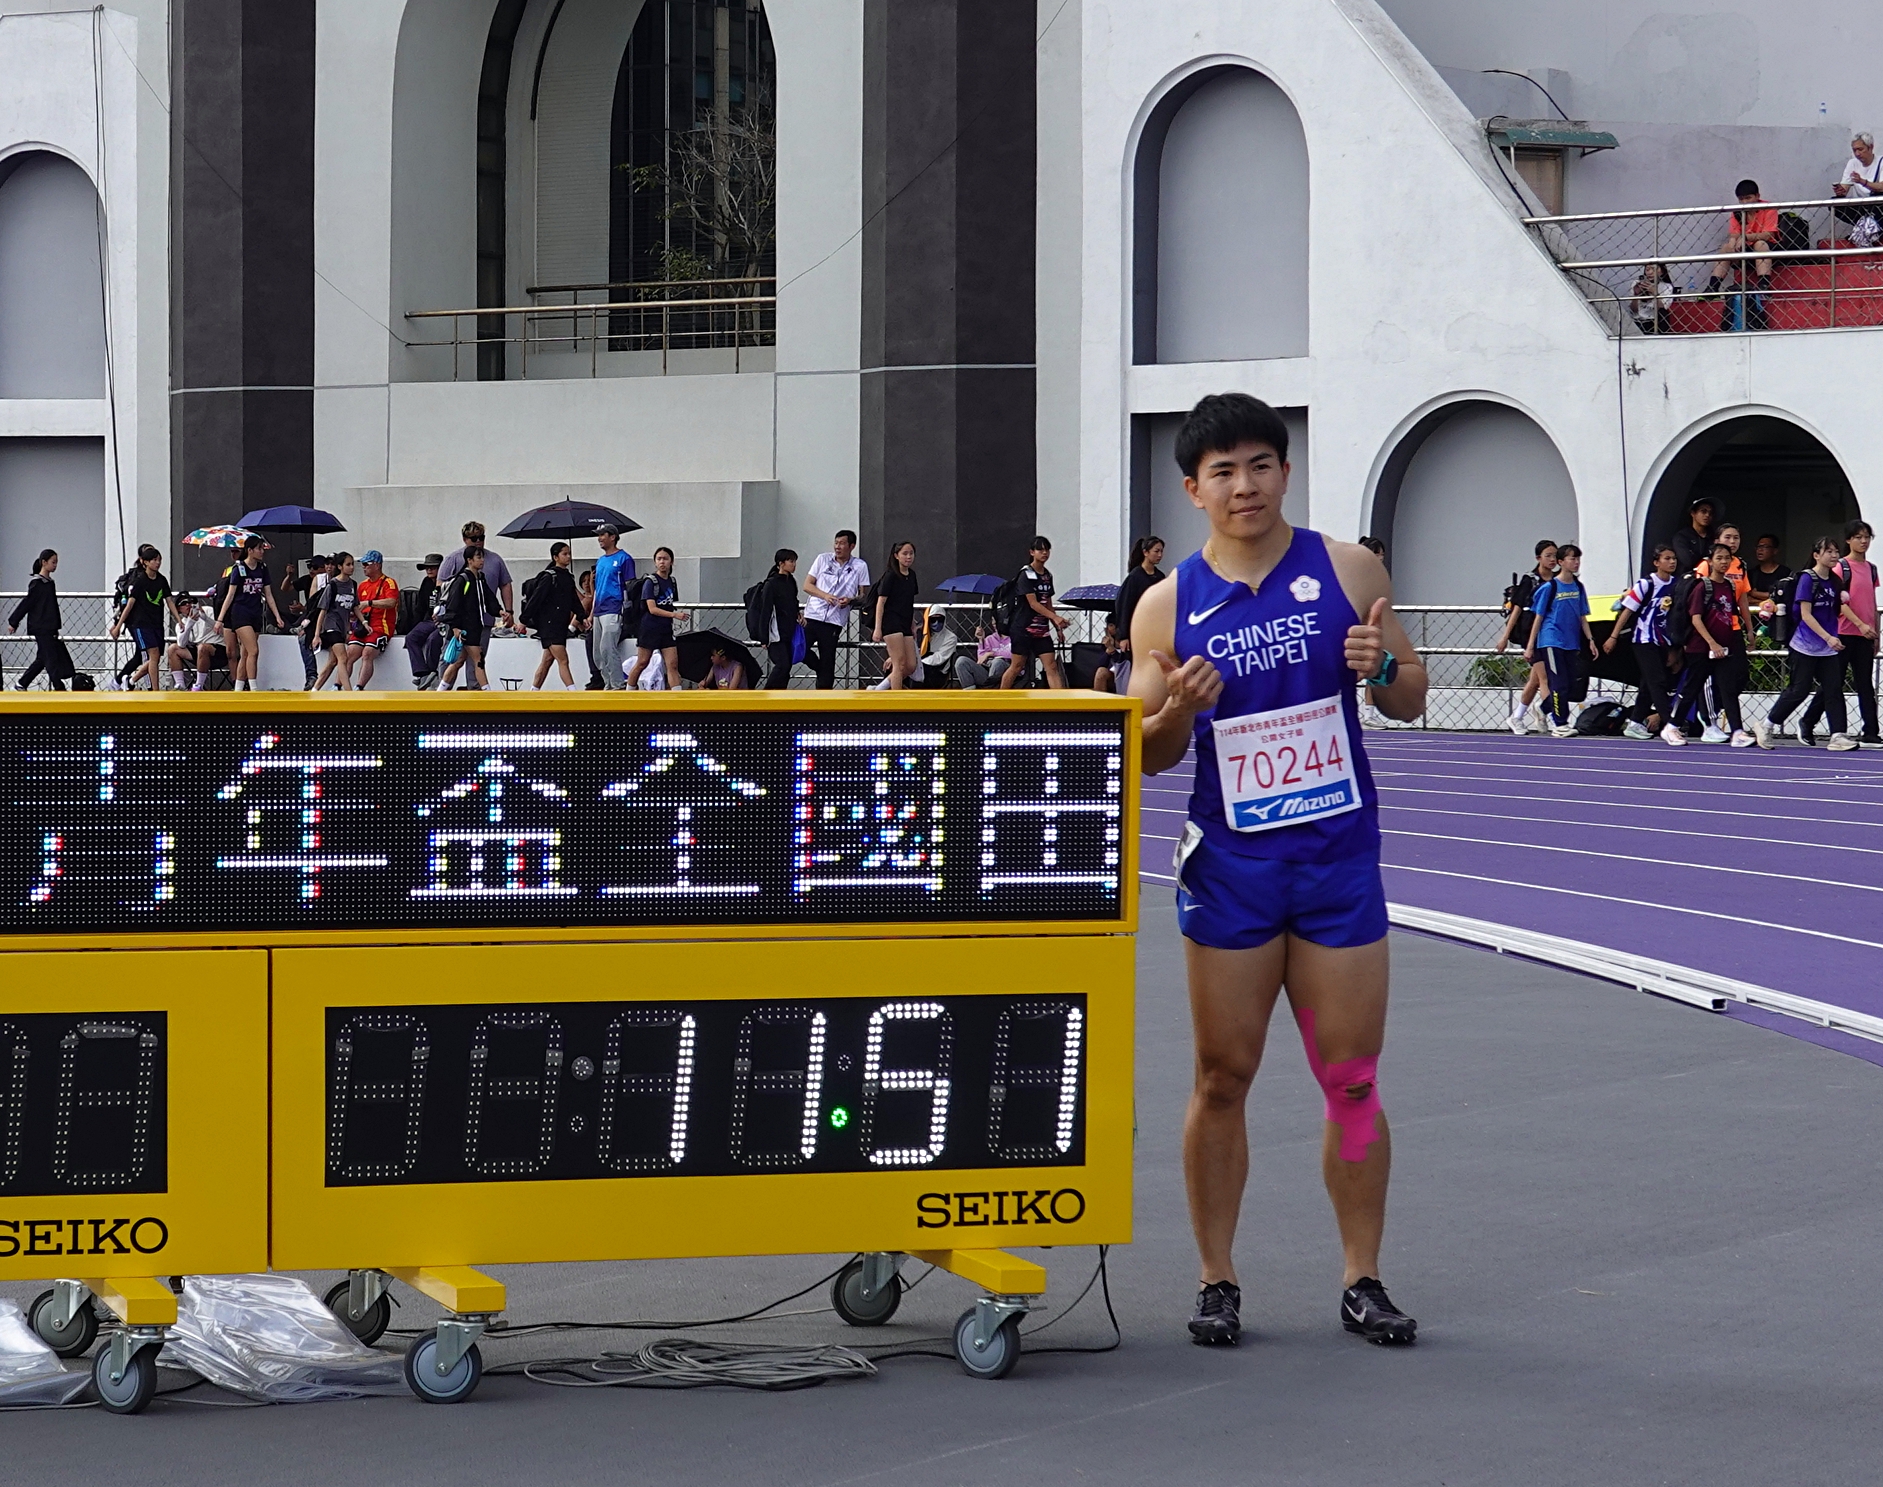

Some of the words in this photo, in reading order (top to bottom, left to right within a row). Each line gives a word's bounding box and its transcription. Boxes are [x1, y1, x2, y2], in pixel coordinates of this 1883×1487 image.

[1206, 611, 1321, 658] CHINESE
[1228, 638, 1308, 677] TAIPEI
[1227, 734, 1344, 793] 70244
[916, 1188, 1086, 1229] SEIKO
